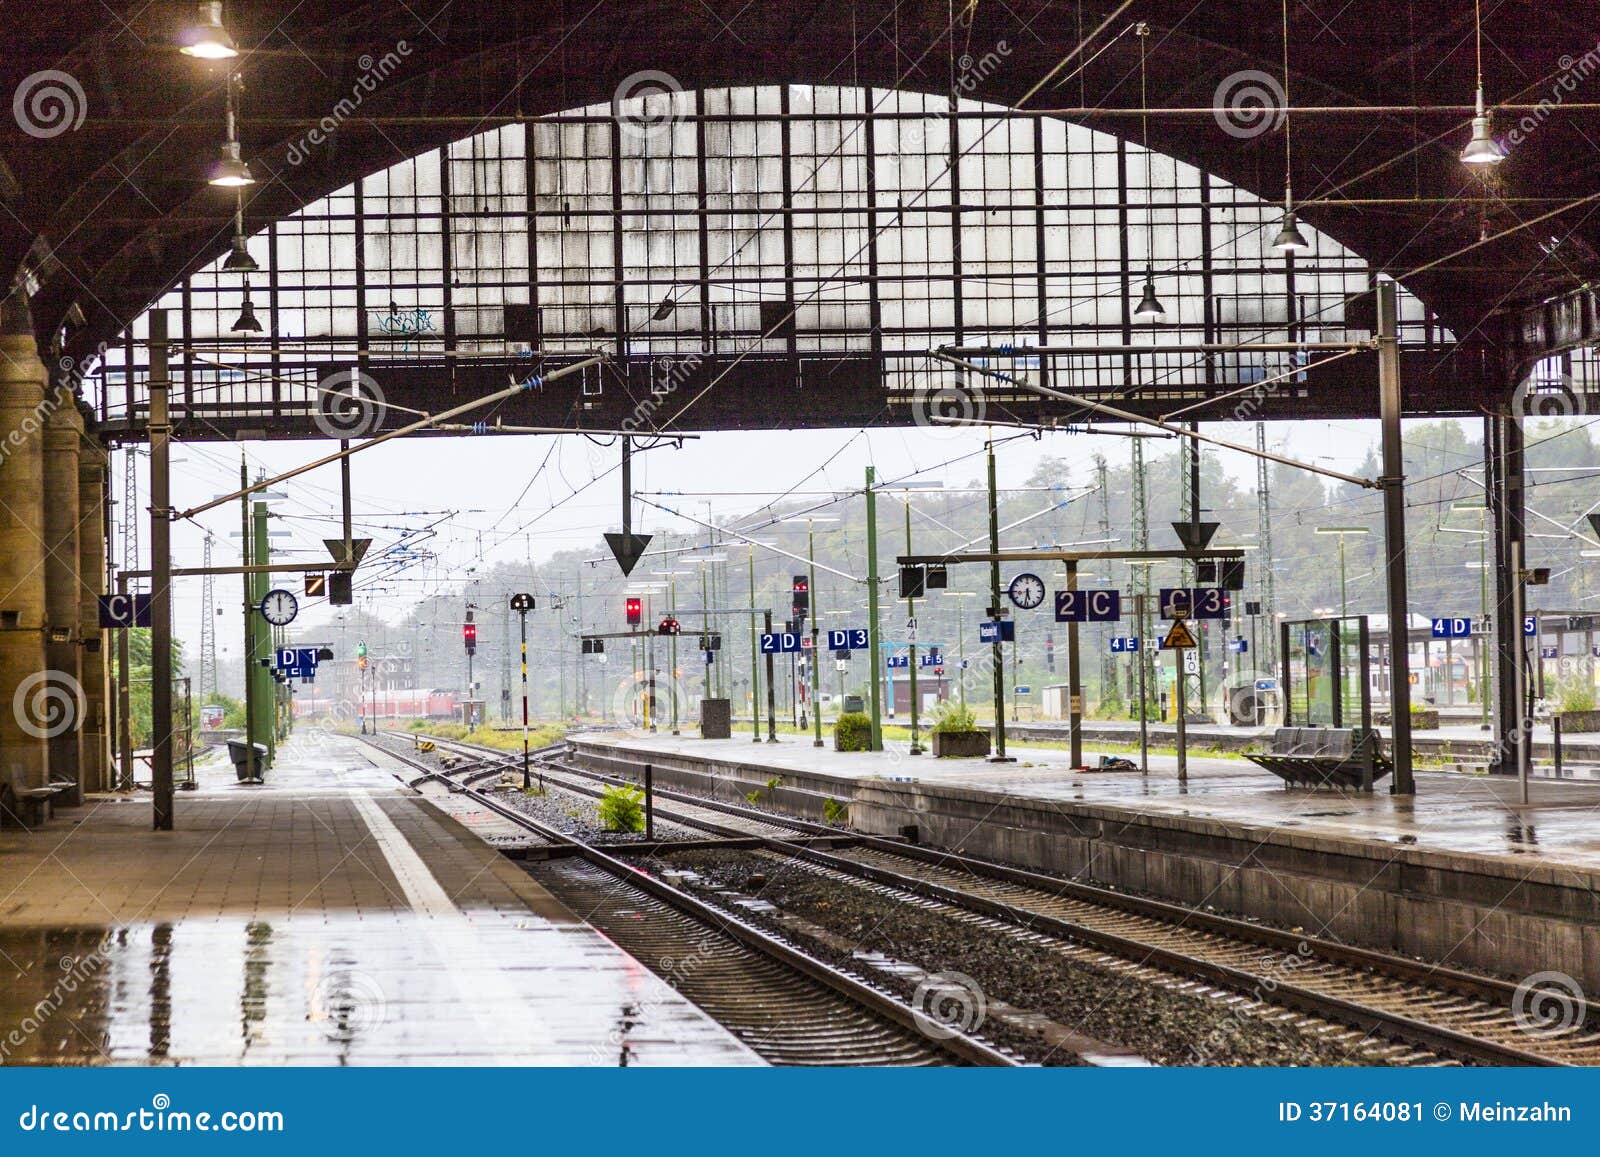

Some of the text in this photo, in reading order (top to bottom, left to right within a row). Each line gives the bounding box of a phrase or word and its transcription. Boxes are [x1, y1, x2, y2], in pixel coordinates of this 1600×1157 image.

[1059, 591, 1110, 615] 2 C
[1205, 588, 1220, 612] 3
[108, 596, 129, 620] C
[906, 618, 918, 630] 41
[1434, 620, 1465, 634] 4 D
[1524, 620, 1534, 632] 5
[763, 634, 795, 649] 2 D
[834, 631, 866, 646] D 3
[1112, 638, 1134, 649] 4 E
[283, 649, 316, 665] D 1
[888, 657, 905, 666] 4 F
[925, 655, 942, 664] F 5
[1186, 651, 1197, 662] 41
